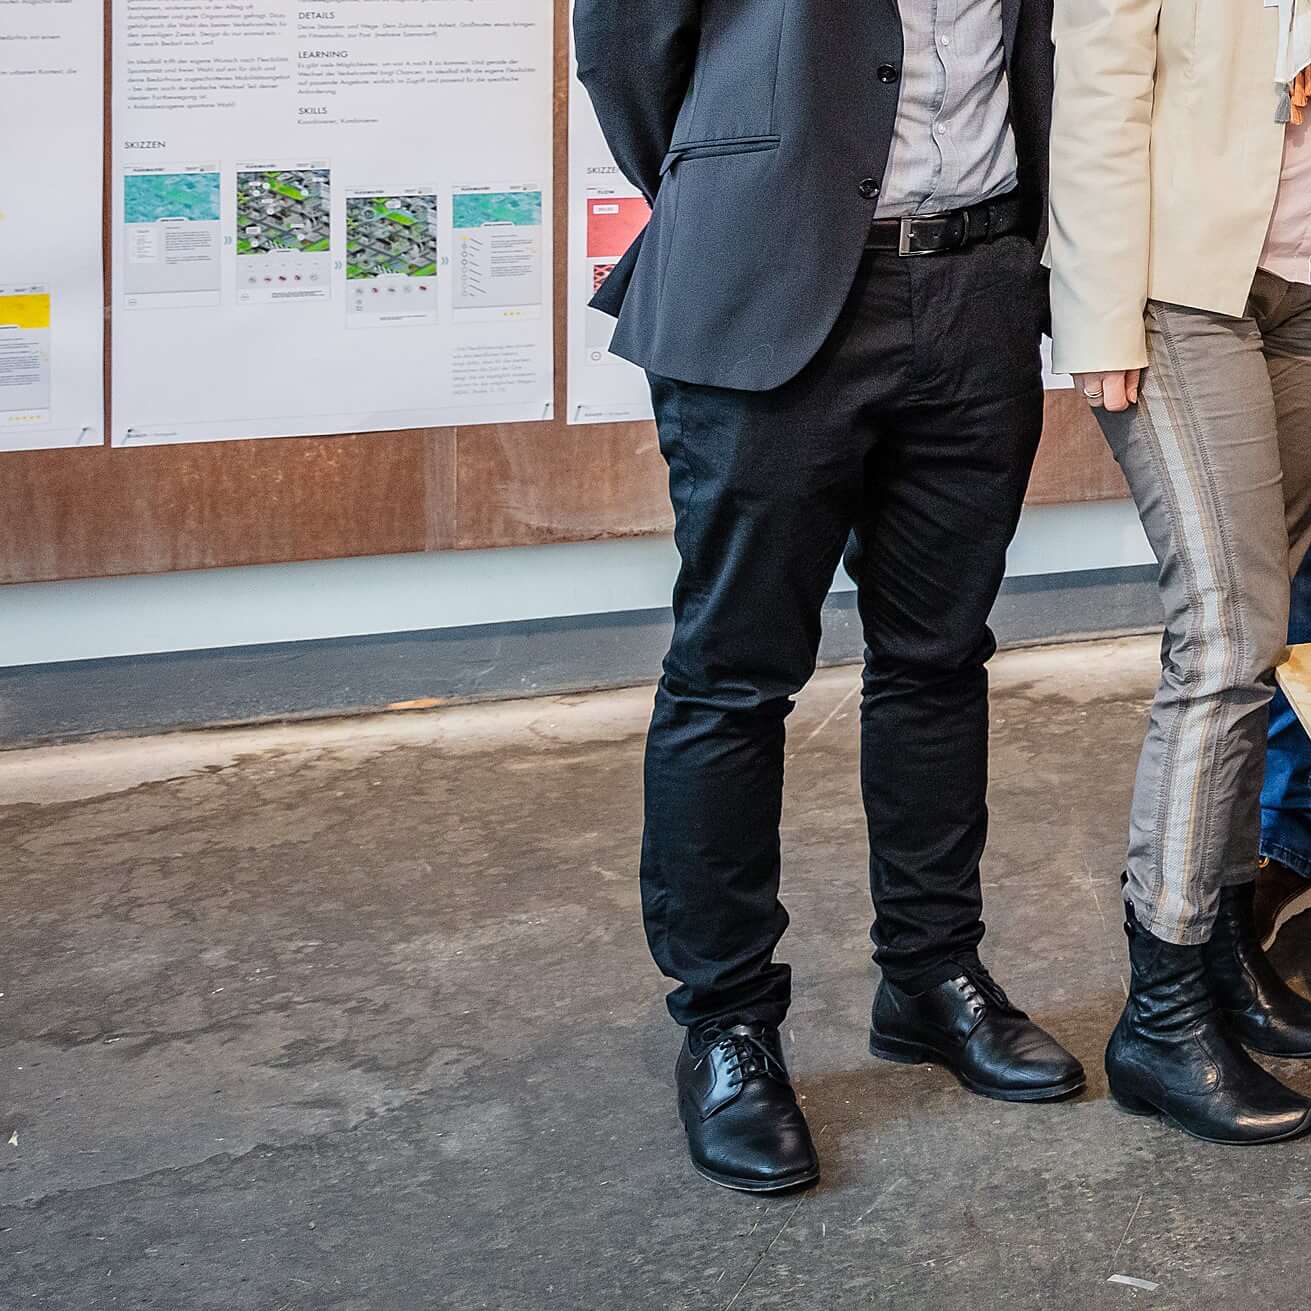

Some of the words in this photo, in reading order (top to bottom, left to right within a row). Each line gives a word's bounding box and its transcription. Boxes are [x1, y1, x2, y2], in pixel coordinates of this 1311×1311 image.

[298, 11, 336, 21] DETAILS
[298, 50, 349, 60] LEARNING
[298, 107, 328, 116] SKILLS
[123, 140, 166, 150] SKIZZEN
[587, 166, 616, 175] SKIZZE
